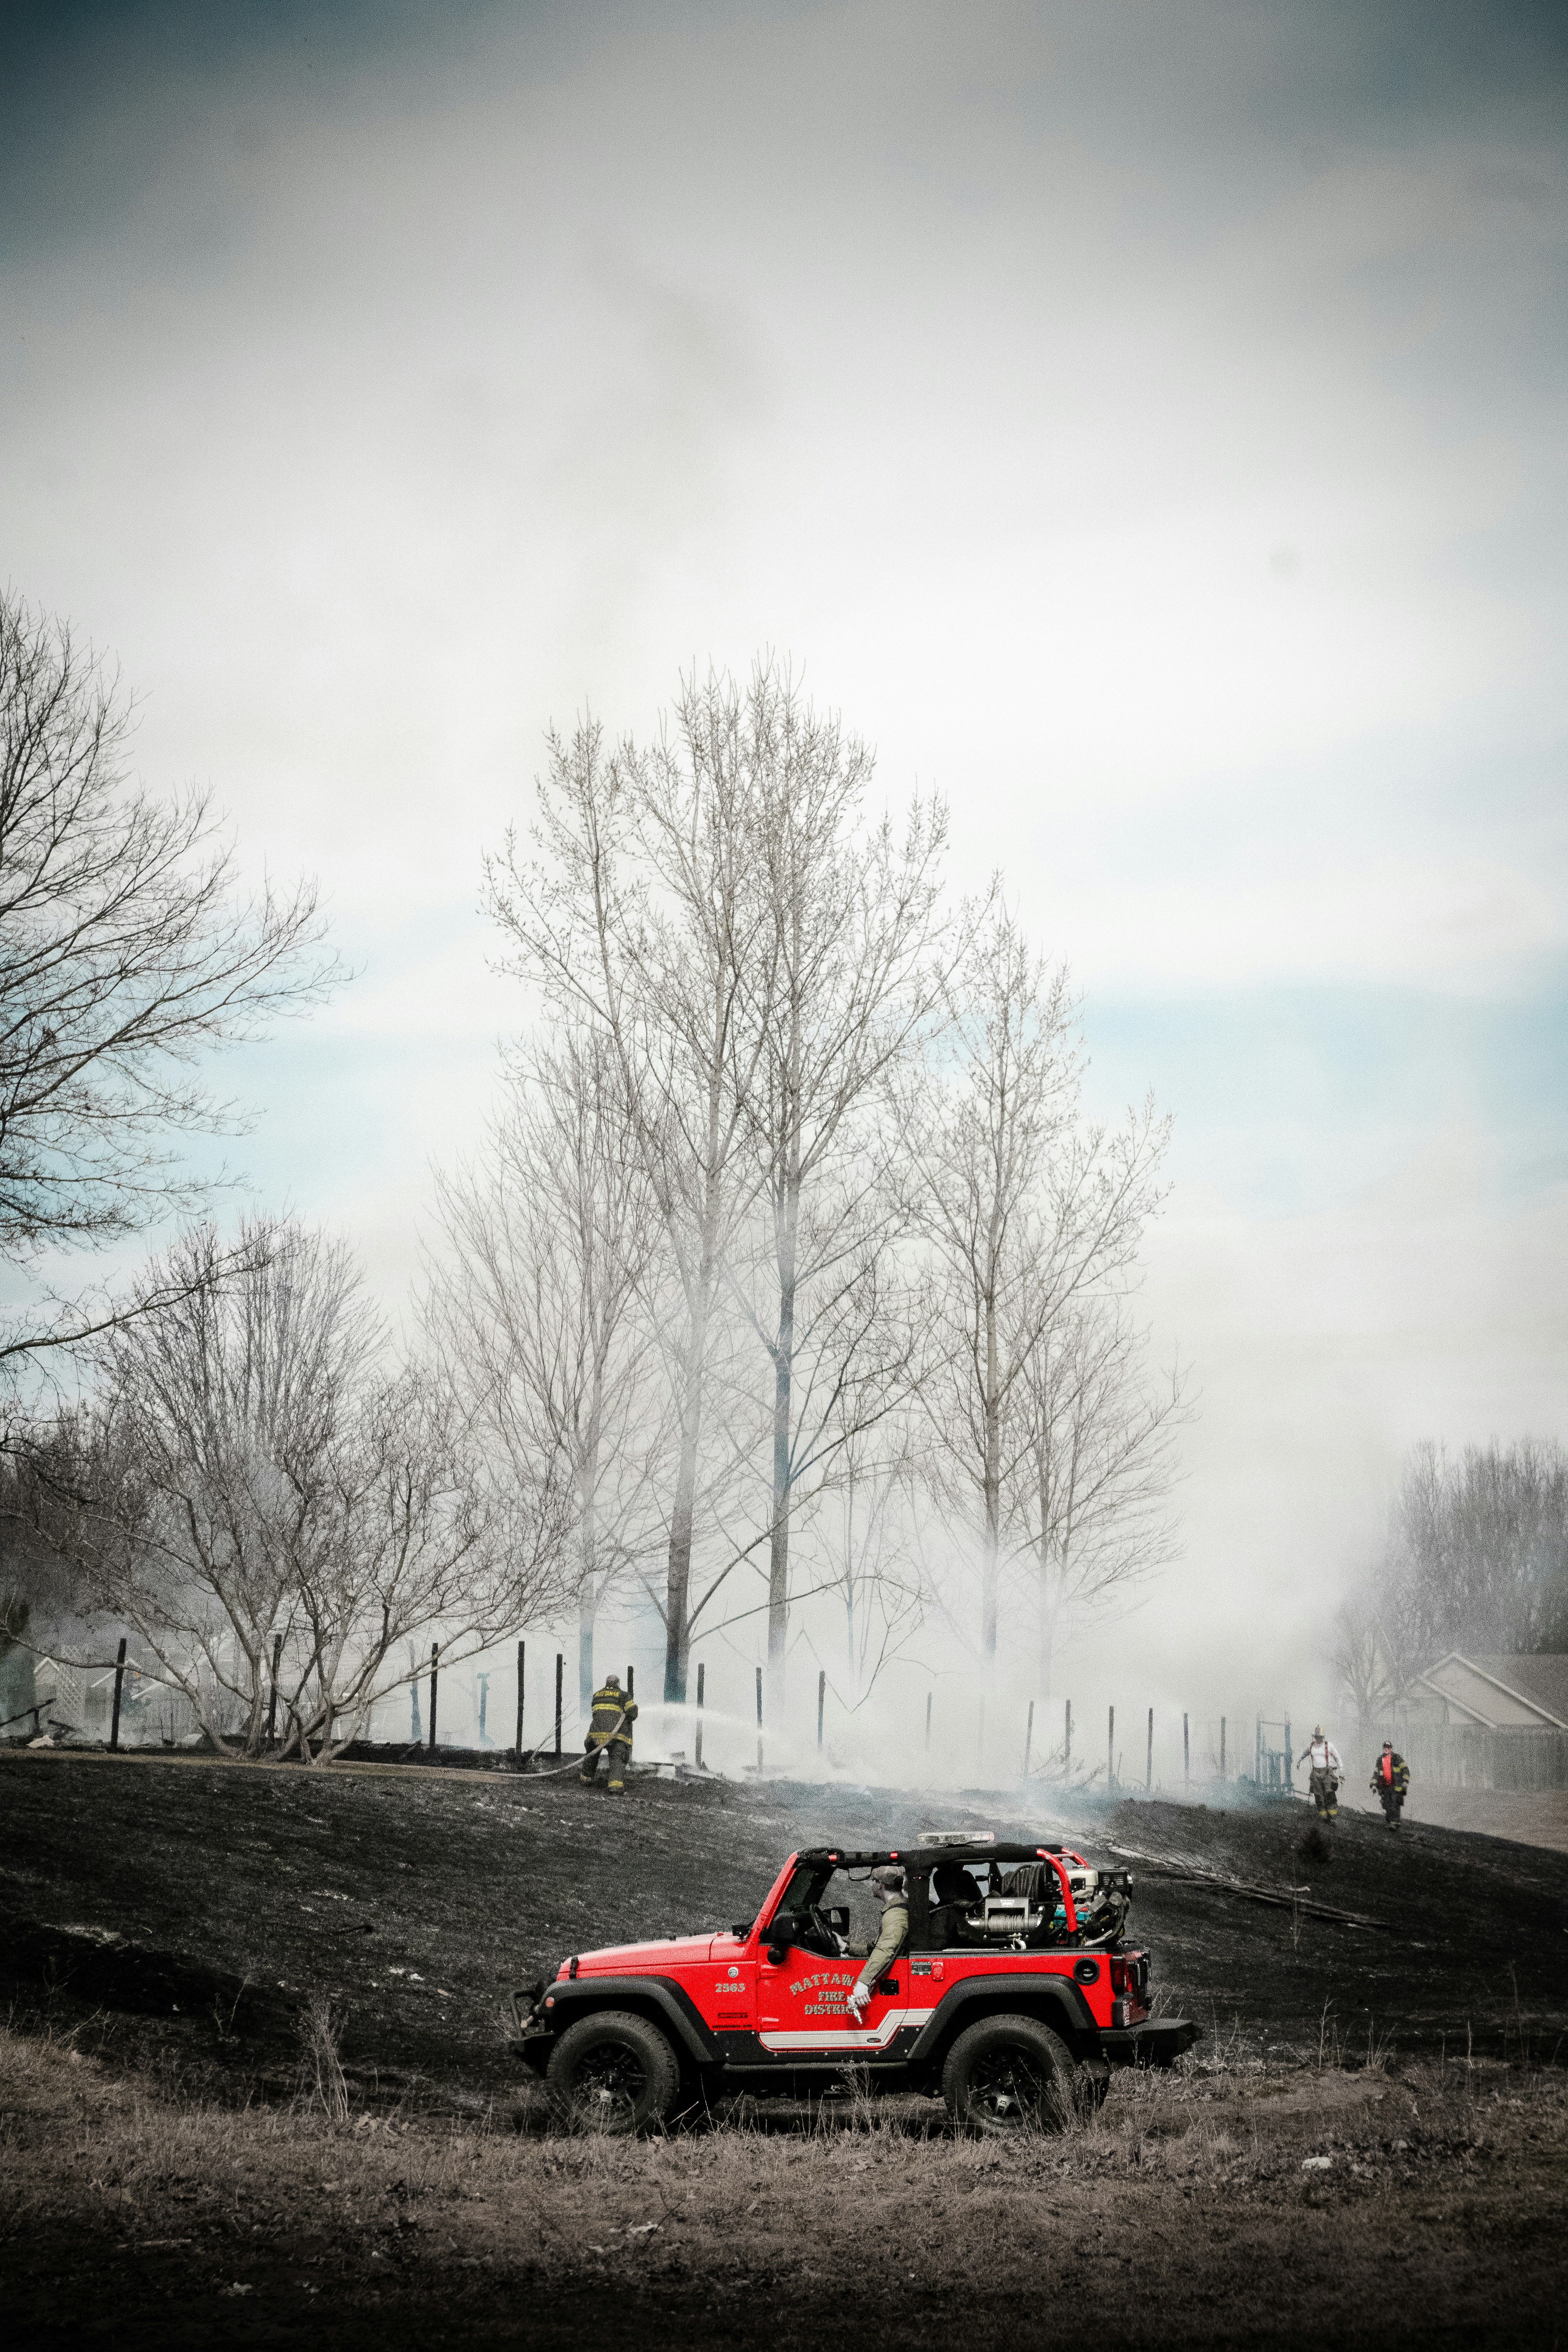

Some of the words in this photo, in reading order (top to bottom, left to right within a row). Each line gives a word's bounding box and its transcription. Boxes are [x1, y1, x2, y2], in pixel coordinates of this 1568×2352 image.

[715, 1983, 745, 1993] 2563
[789, 1973, 855, 1995] MATTAW
[818, 1991, 845, 2002] FIRE
[804, 2004, 853, 2014] DISTRIC
